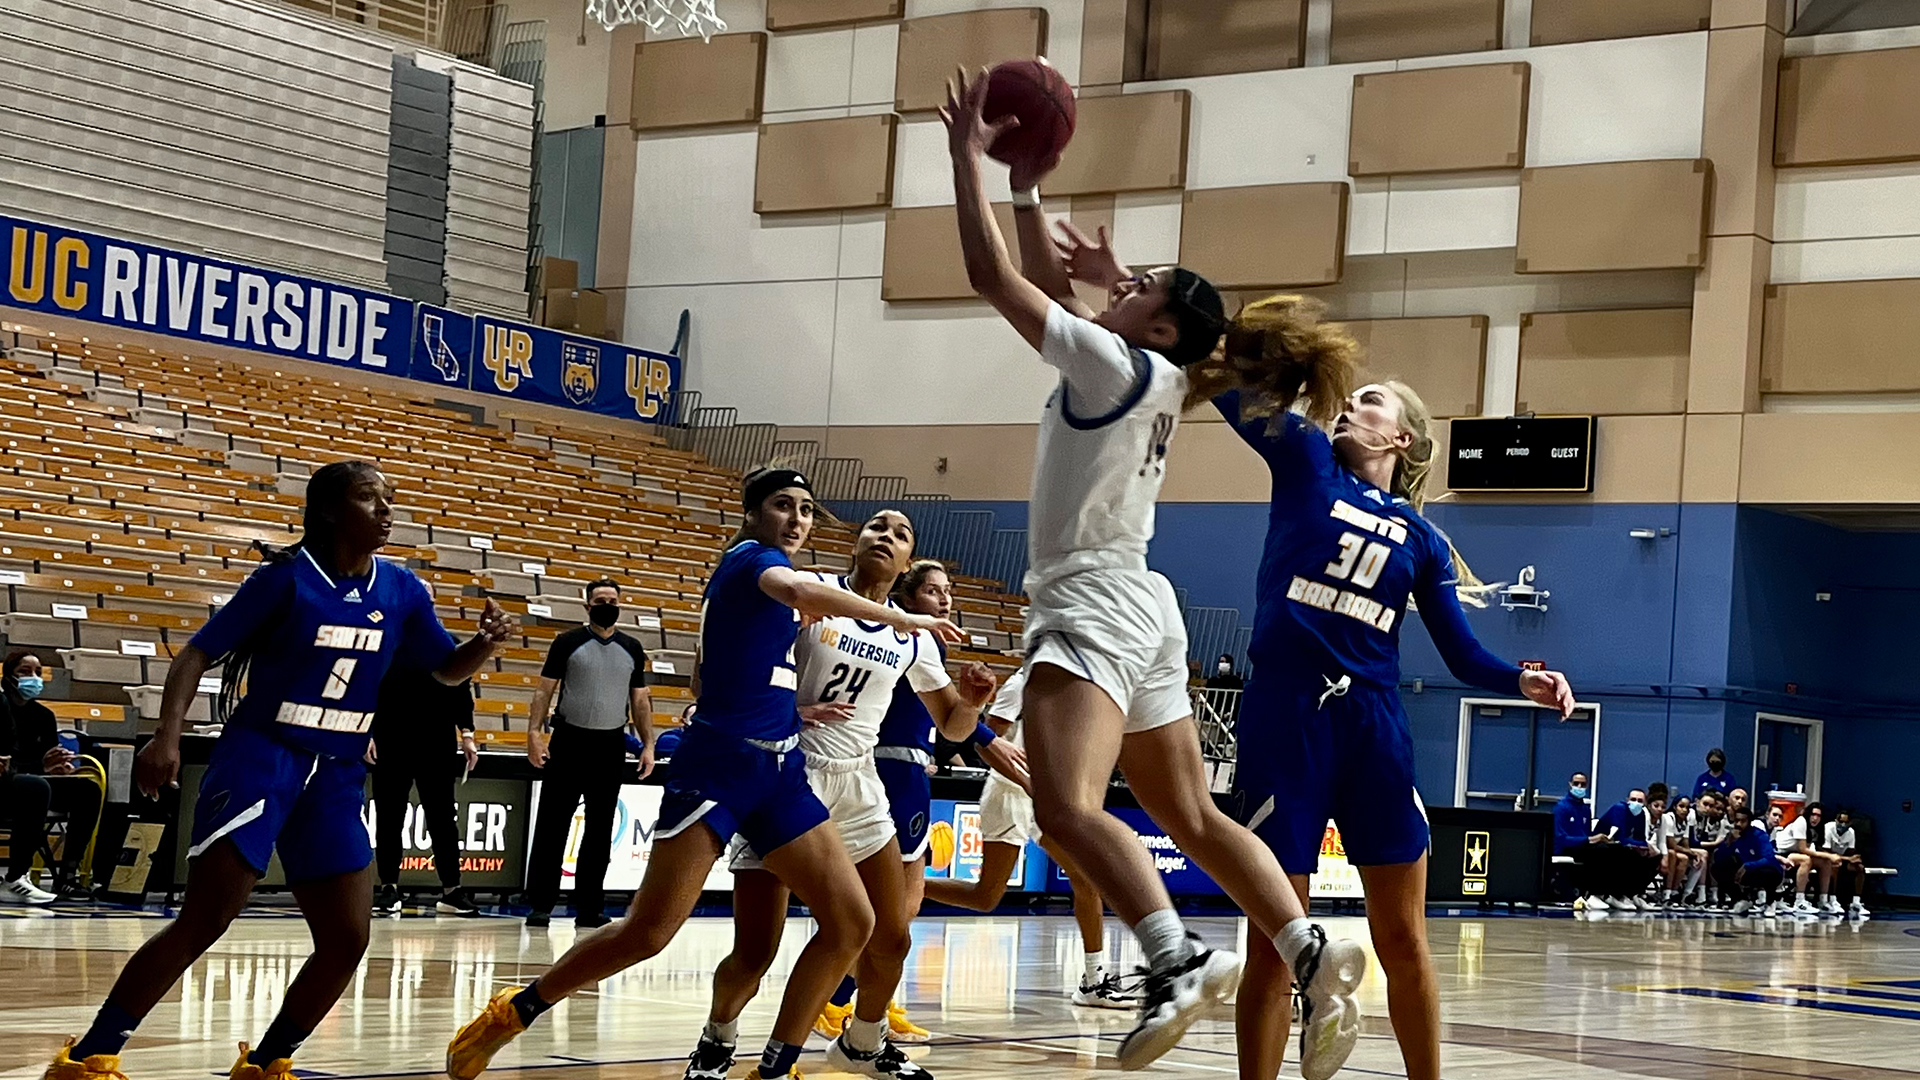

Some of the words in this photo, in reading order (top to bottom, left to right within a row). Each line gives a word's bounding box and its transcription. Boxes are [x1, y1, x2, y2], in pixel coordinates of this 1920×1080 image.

[8, 226, 91, 312] UC
[101, 244, 391, 368] RIVERSIDE
[1458, 448, 1484, 459] HOME
[1505, 447, 1530, 457] PERIOD
[1550, 447, 1580, 459] GUEST
[1324, 531, 1392, 590] 30
[1286, 575, 1397, 634] BARBARA
[313, 624, 384, 652] SANTA
[819, 626, 840, 648] UC
[837, 633, 902, 670] RIVERSIDE
[321, 657, 358, 700] 0
[818, 661, 872, 705] 24
